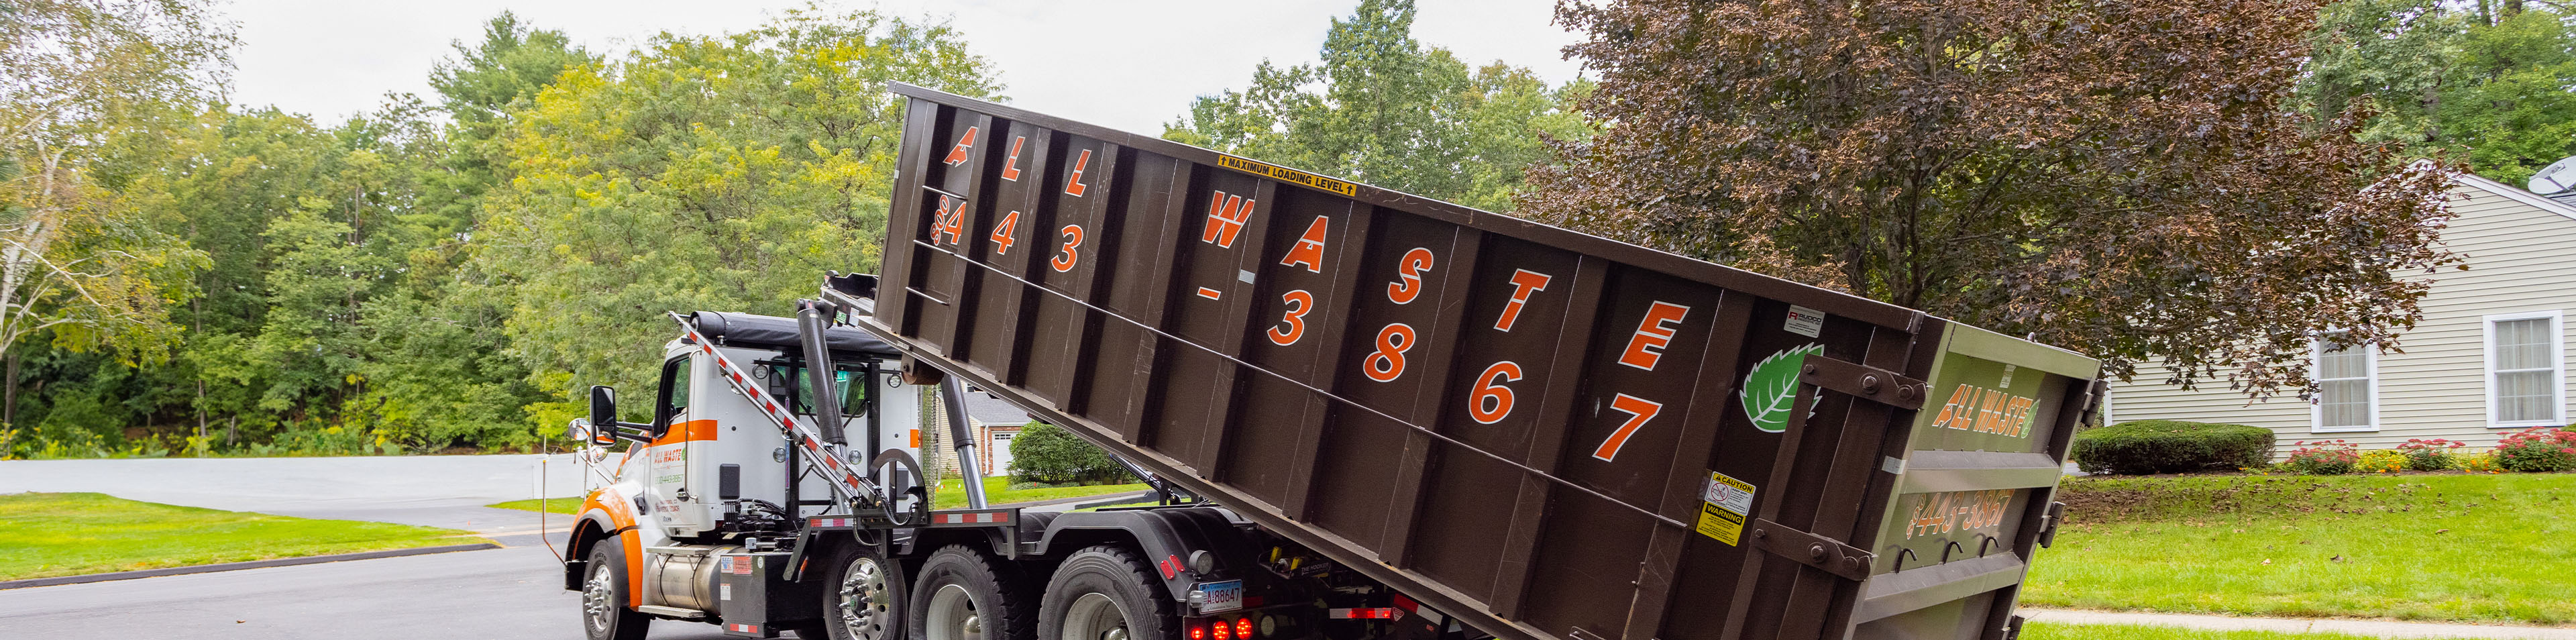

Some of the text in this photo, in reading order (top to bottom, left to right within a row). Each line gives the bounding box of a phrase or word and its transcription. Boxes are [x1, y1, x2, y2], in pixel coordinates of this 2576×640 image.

[1228, 158, 1344, 193] MAXIMUM LOADING LEVEL
[1932, 384, 2033, 437] ALL WASTE
[663, 449, 682, 462] WASTE
[1722, 477, 1753, 492] CAUTION
[1707, 505, 1742, 523] WARNING
